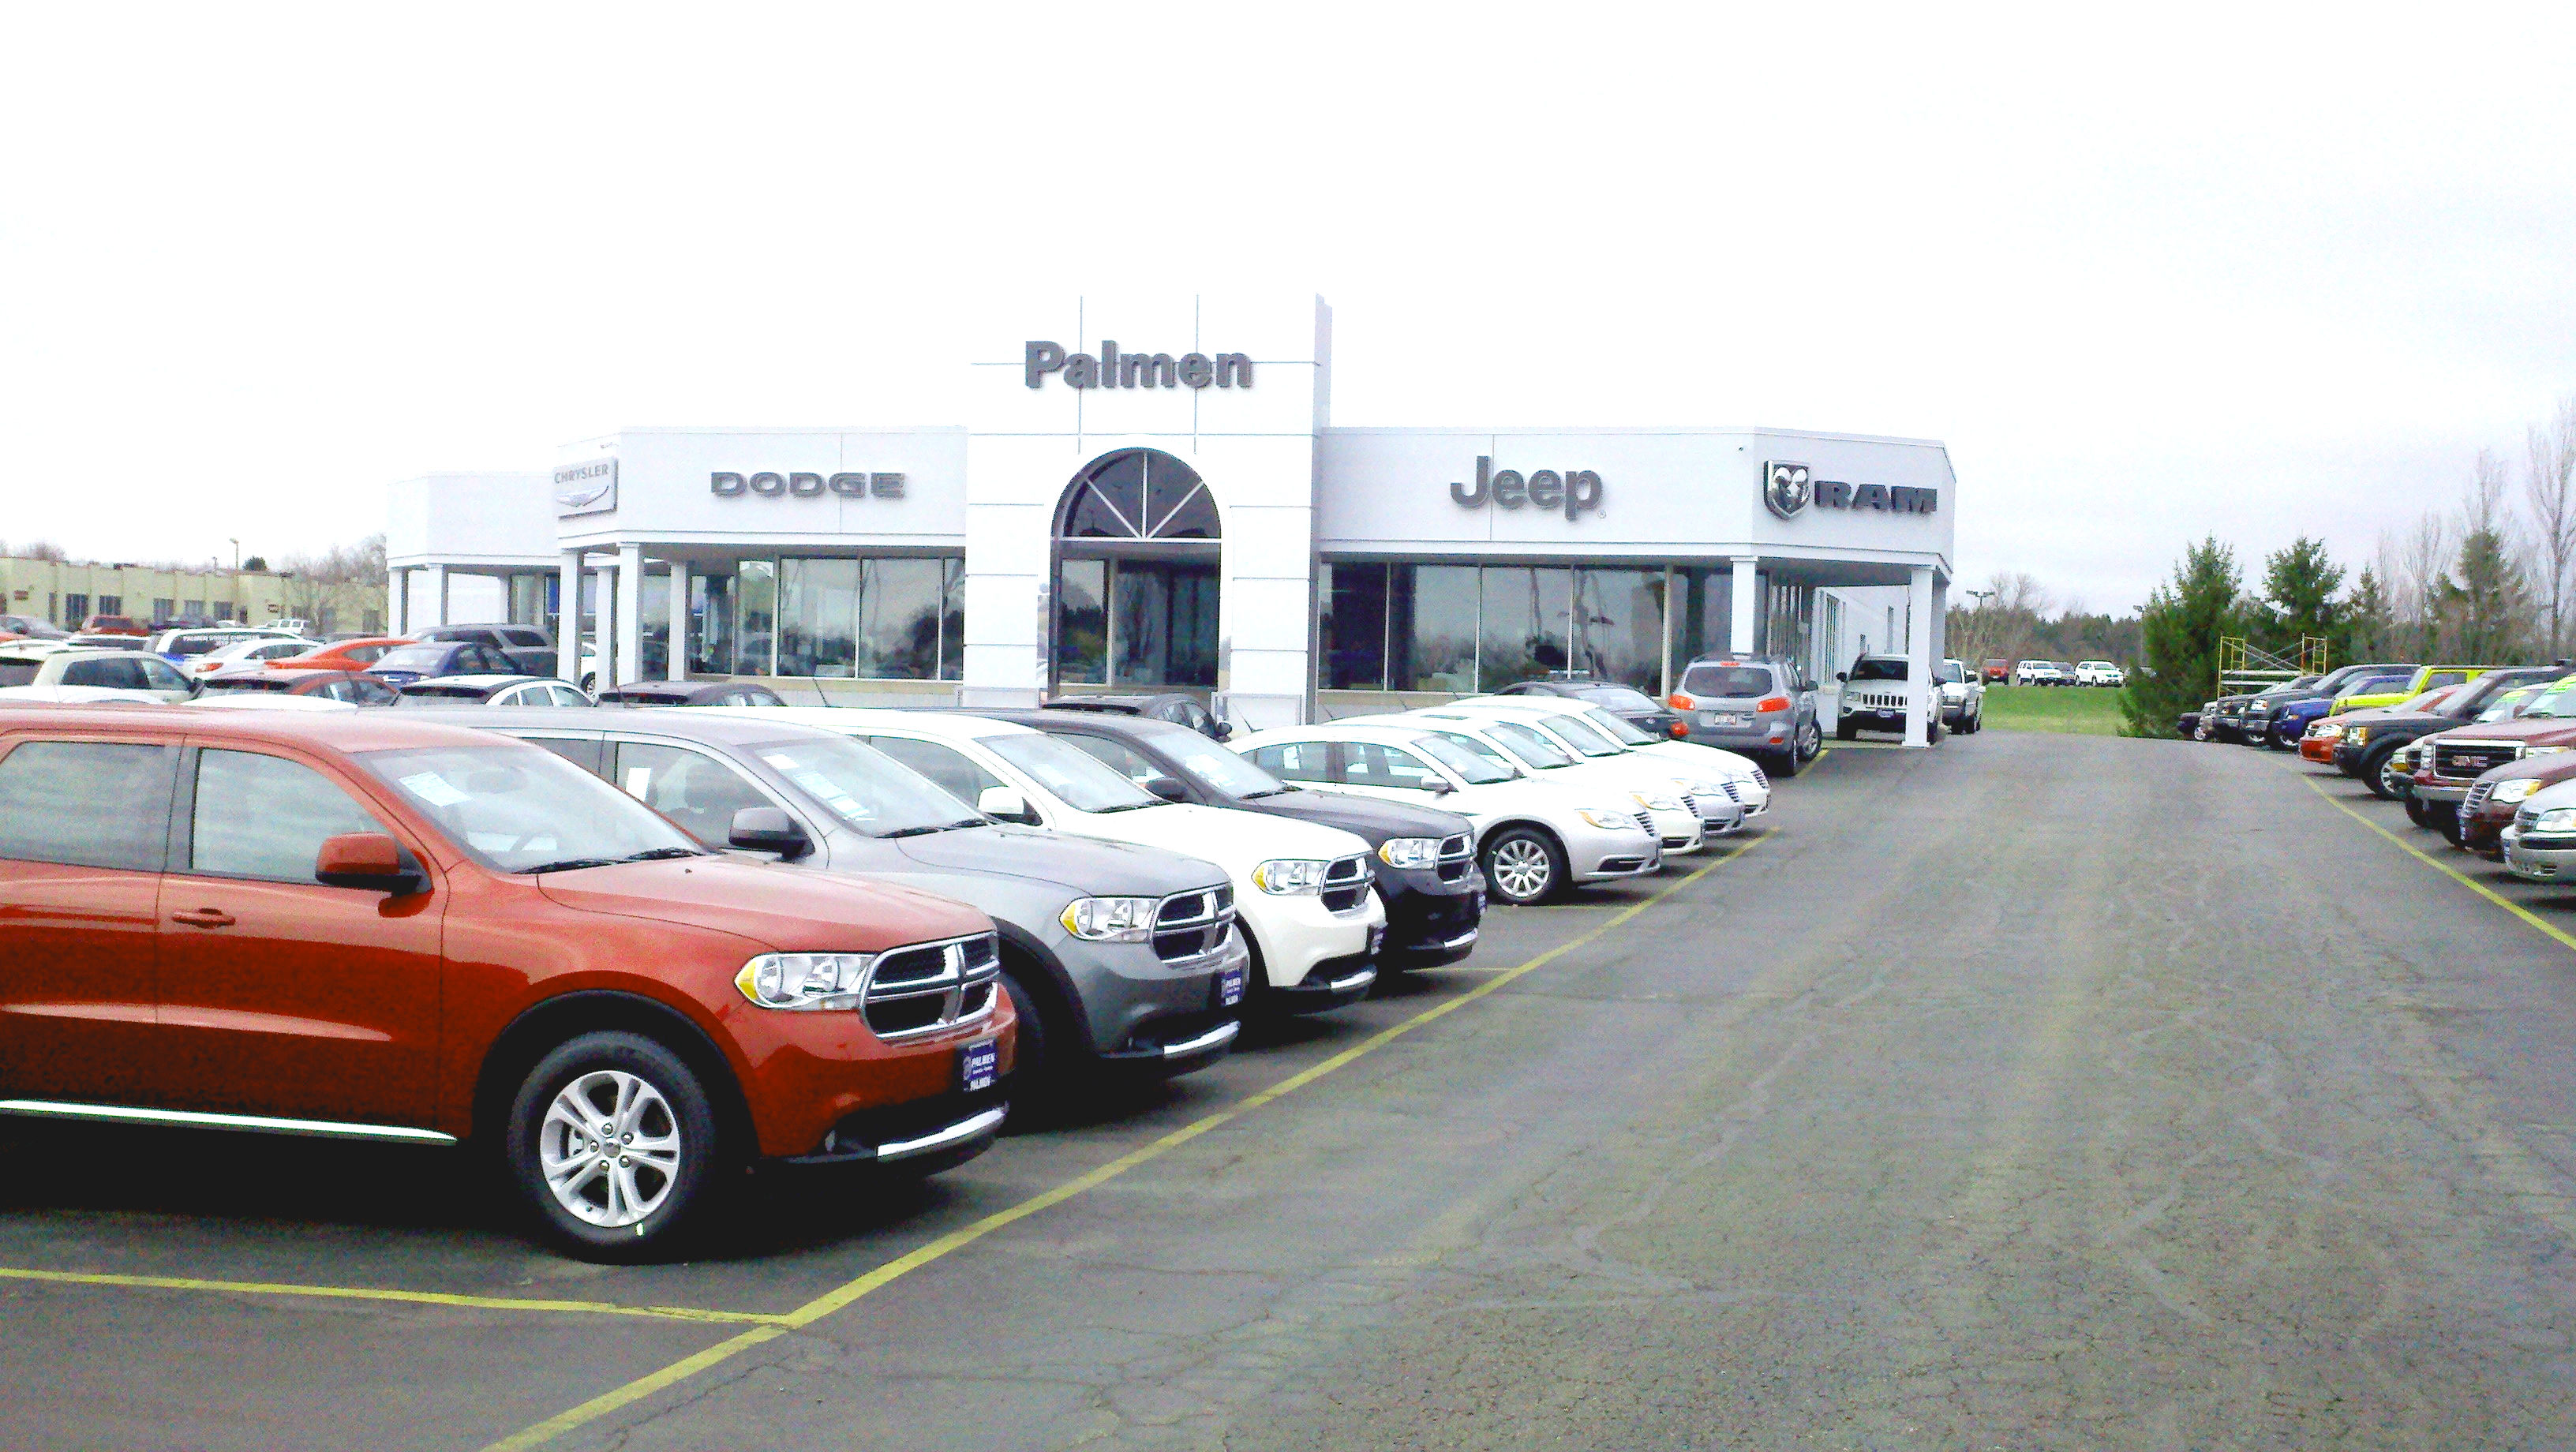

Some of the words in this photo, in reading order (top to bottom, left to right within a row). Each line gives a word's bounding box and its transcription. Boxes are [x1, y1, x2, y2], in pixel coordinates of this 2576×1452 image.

[1025, 340, 1252, 389] Palmen
[554, 464, 608, 484] CHRYSLER
[711, 472, 904, 498] DODGE
[1450, 455, 1602, 521] Jeep
[1814, 481, 1938, 513] RAM
[2452, 755, 2488, 768] GMC
